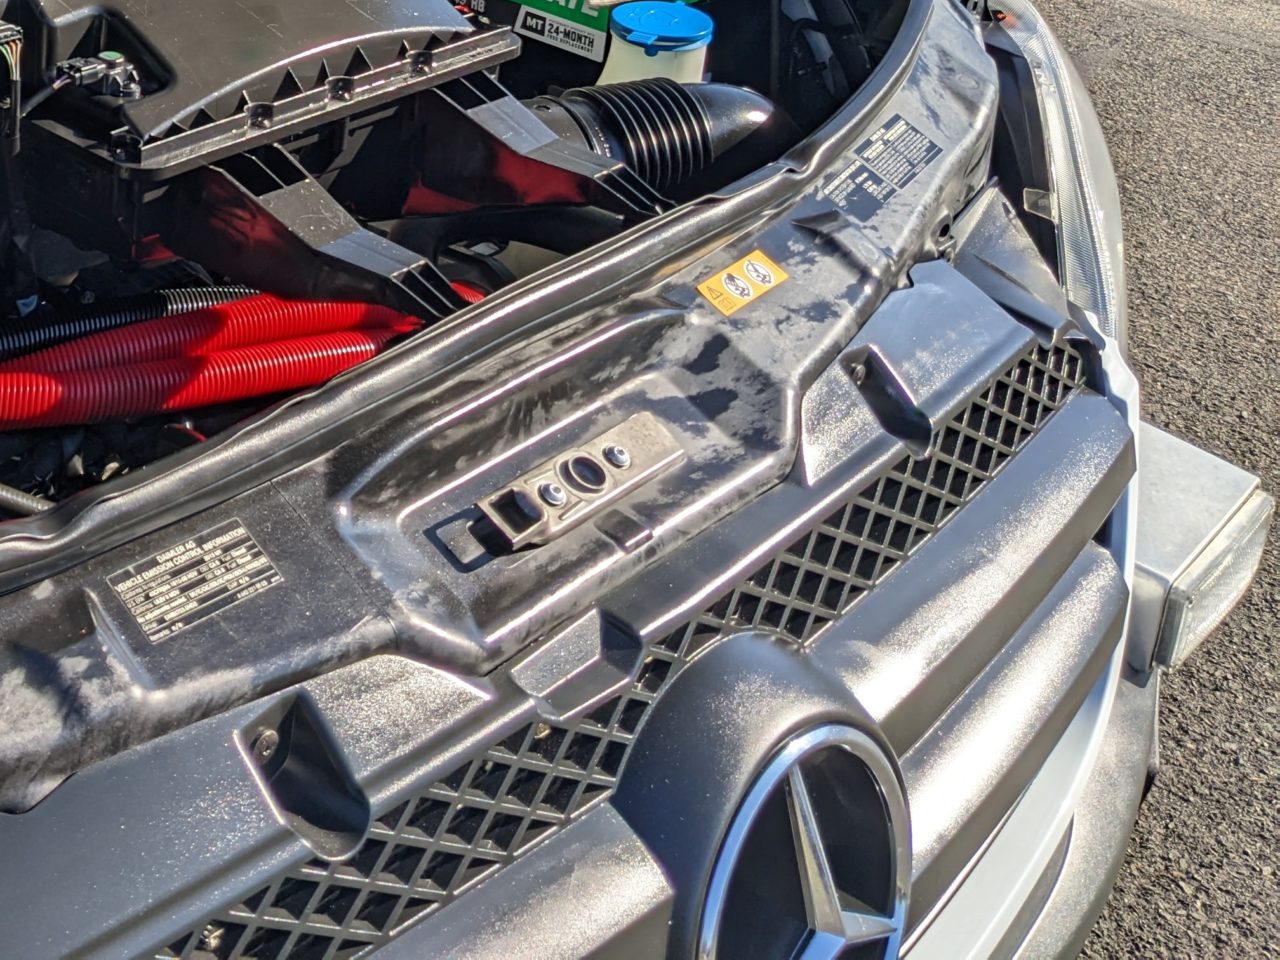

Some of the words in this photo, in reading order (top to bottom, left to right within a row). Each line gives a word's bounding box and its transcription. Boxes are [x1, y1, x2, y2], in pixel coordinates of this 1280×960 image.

[526, 16, 544, 30] MT
[547, 24, 595, 48] 24-MONTH
[115, 575, 143, 592] VEHICLE
[142, 561, 174, 579] EMISSION
[173, 548, 203, 564] CONTROL
[203, 528, 245, 550] INFORMATION
[157, 546, 185, 562] DAIMLER
[185, 541, 195, 549] AG
